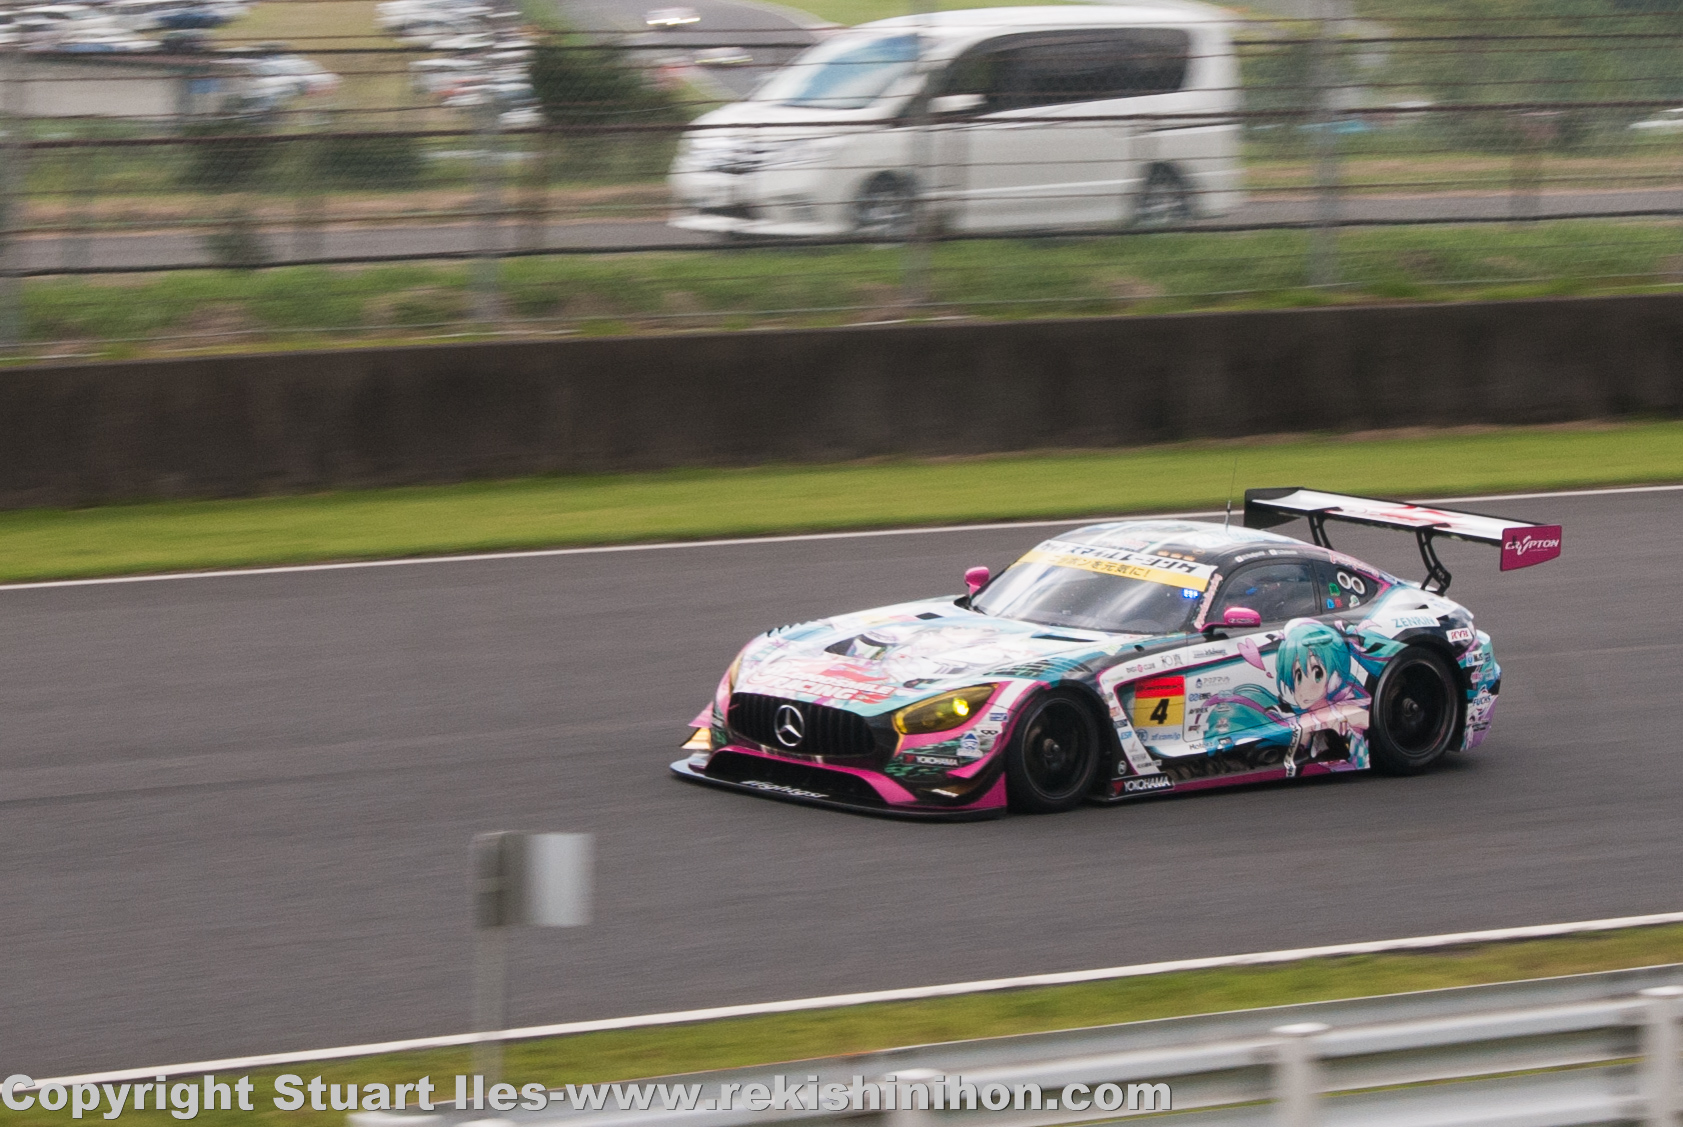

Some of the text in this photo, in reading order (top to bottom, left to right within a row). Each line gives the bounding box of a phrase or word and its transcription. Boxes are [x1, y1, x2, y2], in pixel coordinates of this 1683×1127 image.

[1504, 535, 1560, 556] CRYPTON
[1390, 616, 1436, 628] ZENRIN
[1472, 695, 1491, 707] FUCHS
[1149, 698, 1170, 725] 4
[916, 755, 959, 767] YOKOHAMA
[1123, 776, 1172, 792] YOKOHAMA
